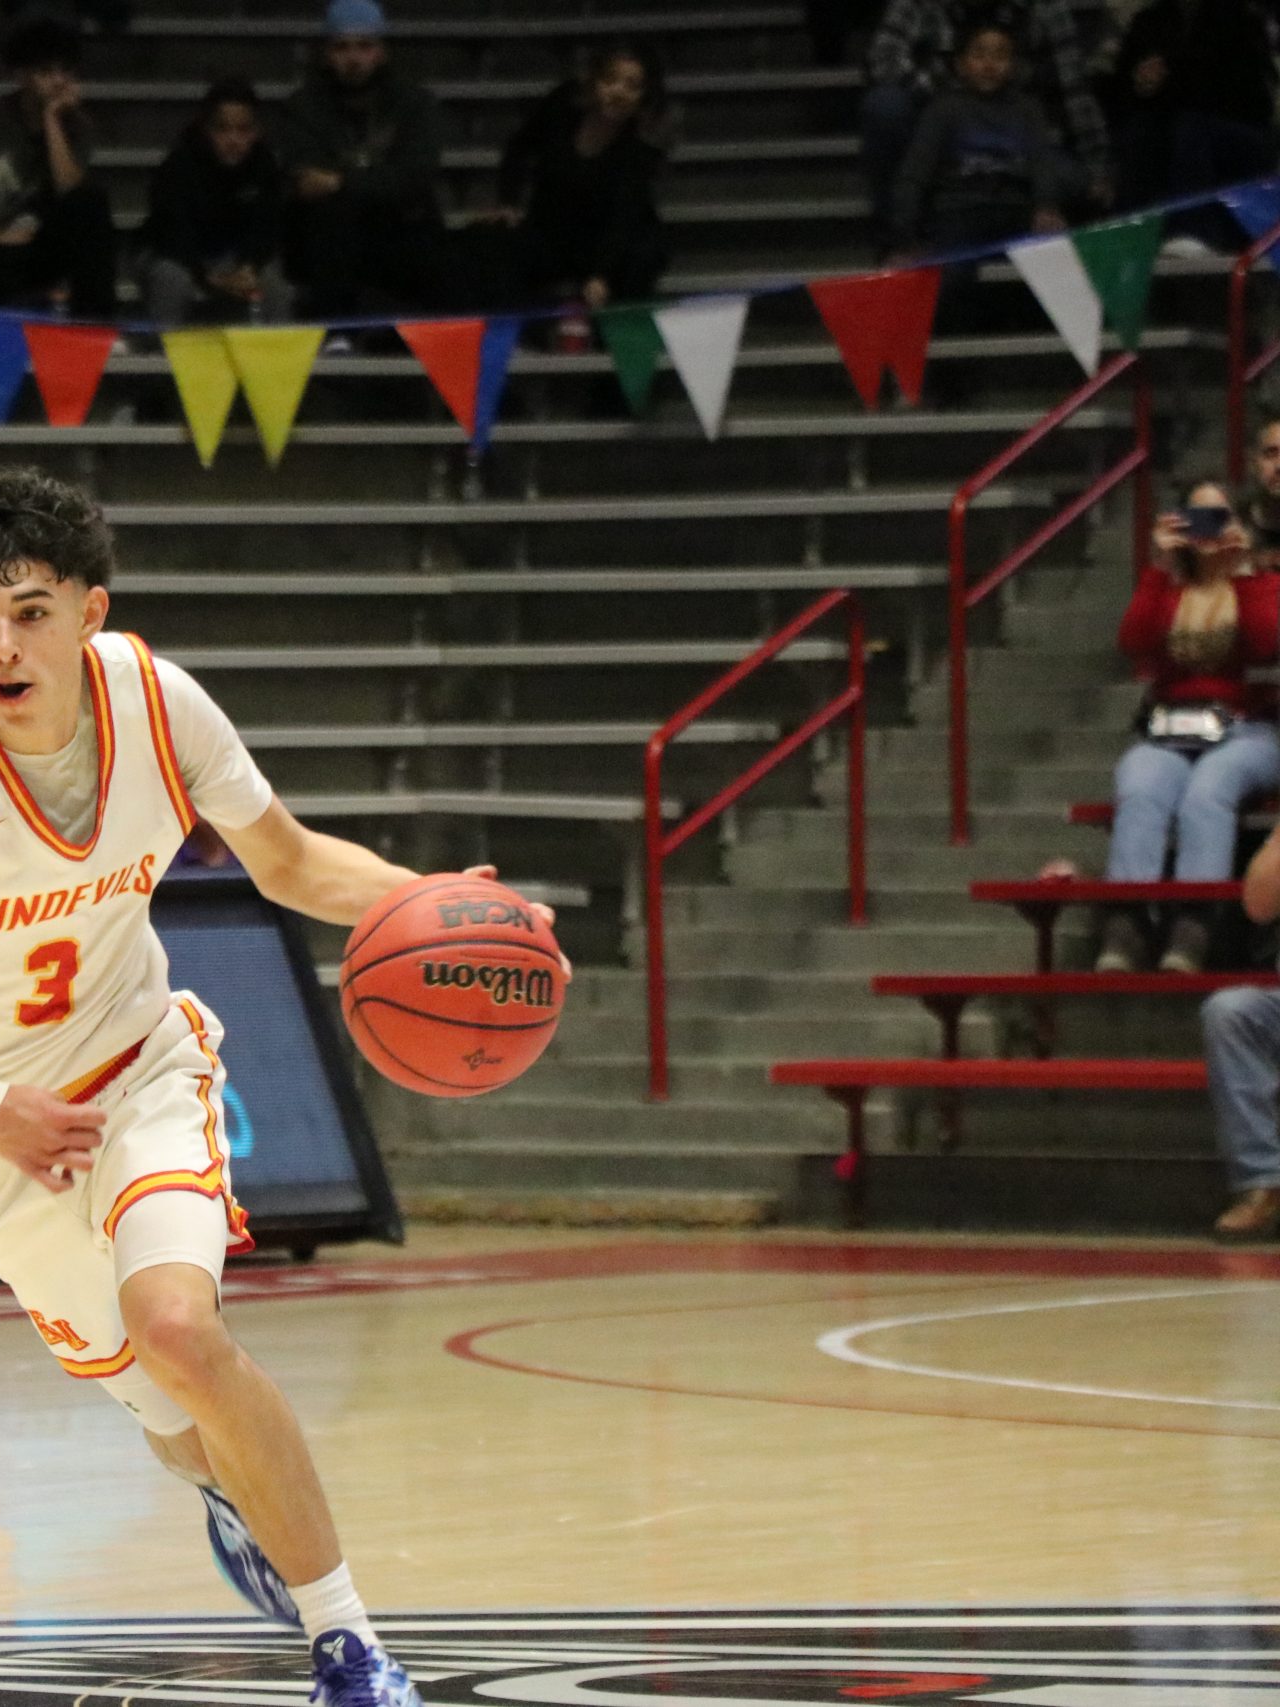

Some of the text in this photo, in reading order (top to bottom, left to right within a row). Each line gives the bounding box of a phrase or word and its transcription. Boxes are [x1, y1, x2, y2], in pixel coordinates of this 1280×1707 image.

[436, 899, 535, 934] NCAA
[14, 935, 81, 1030] 3
[420, 959, 555, 1009] Wilson
